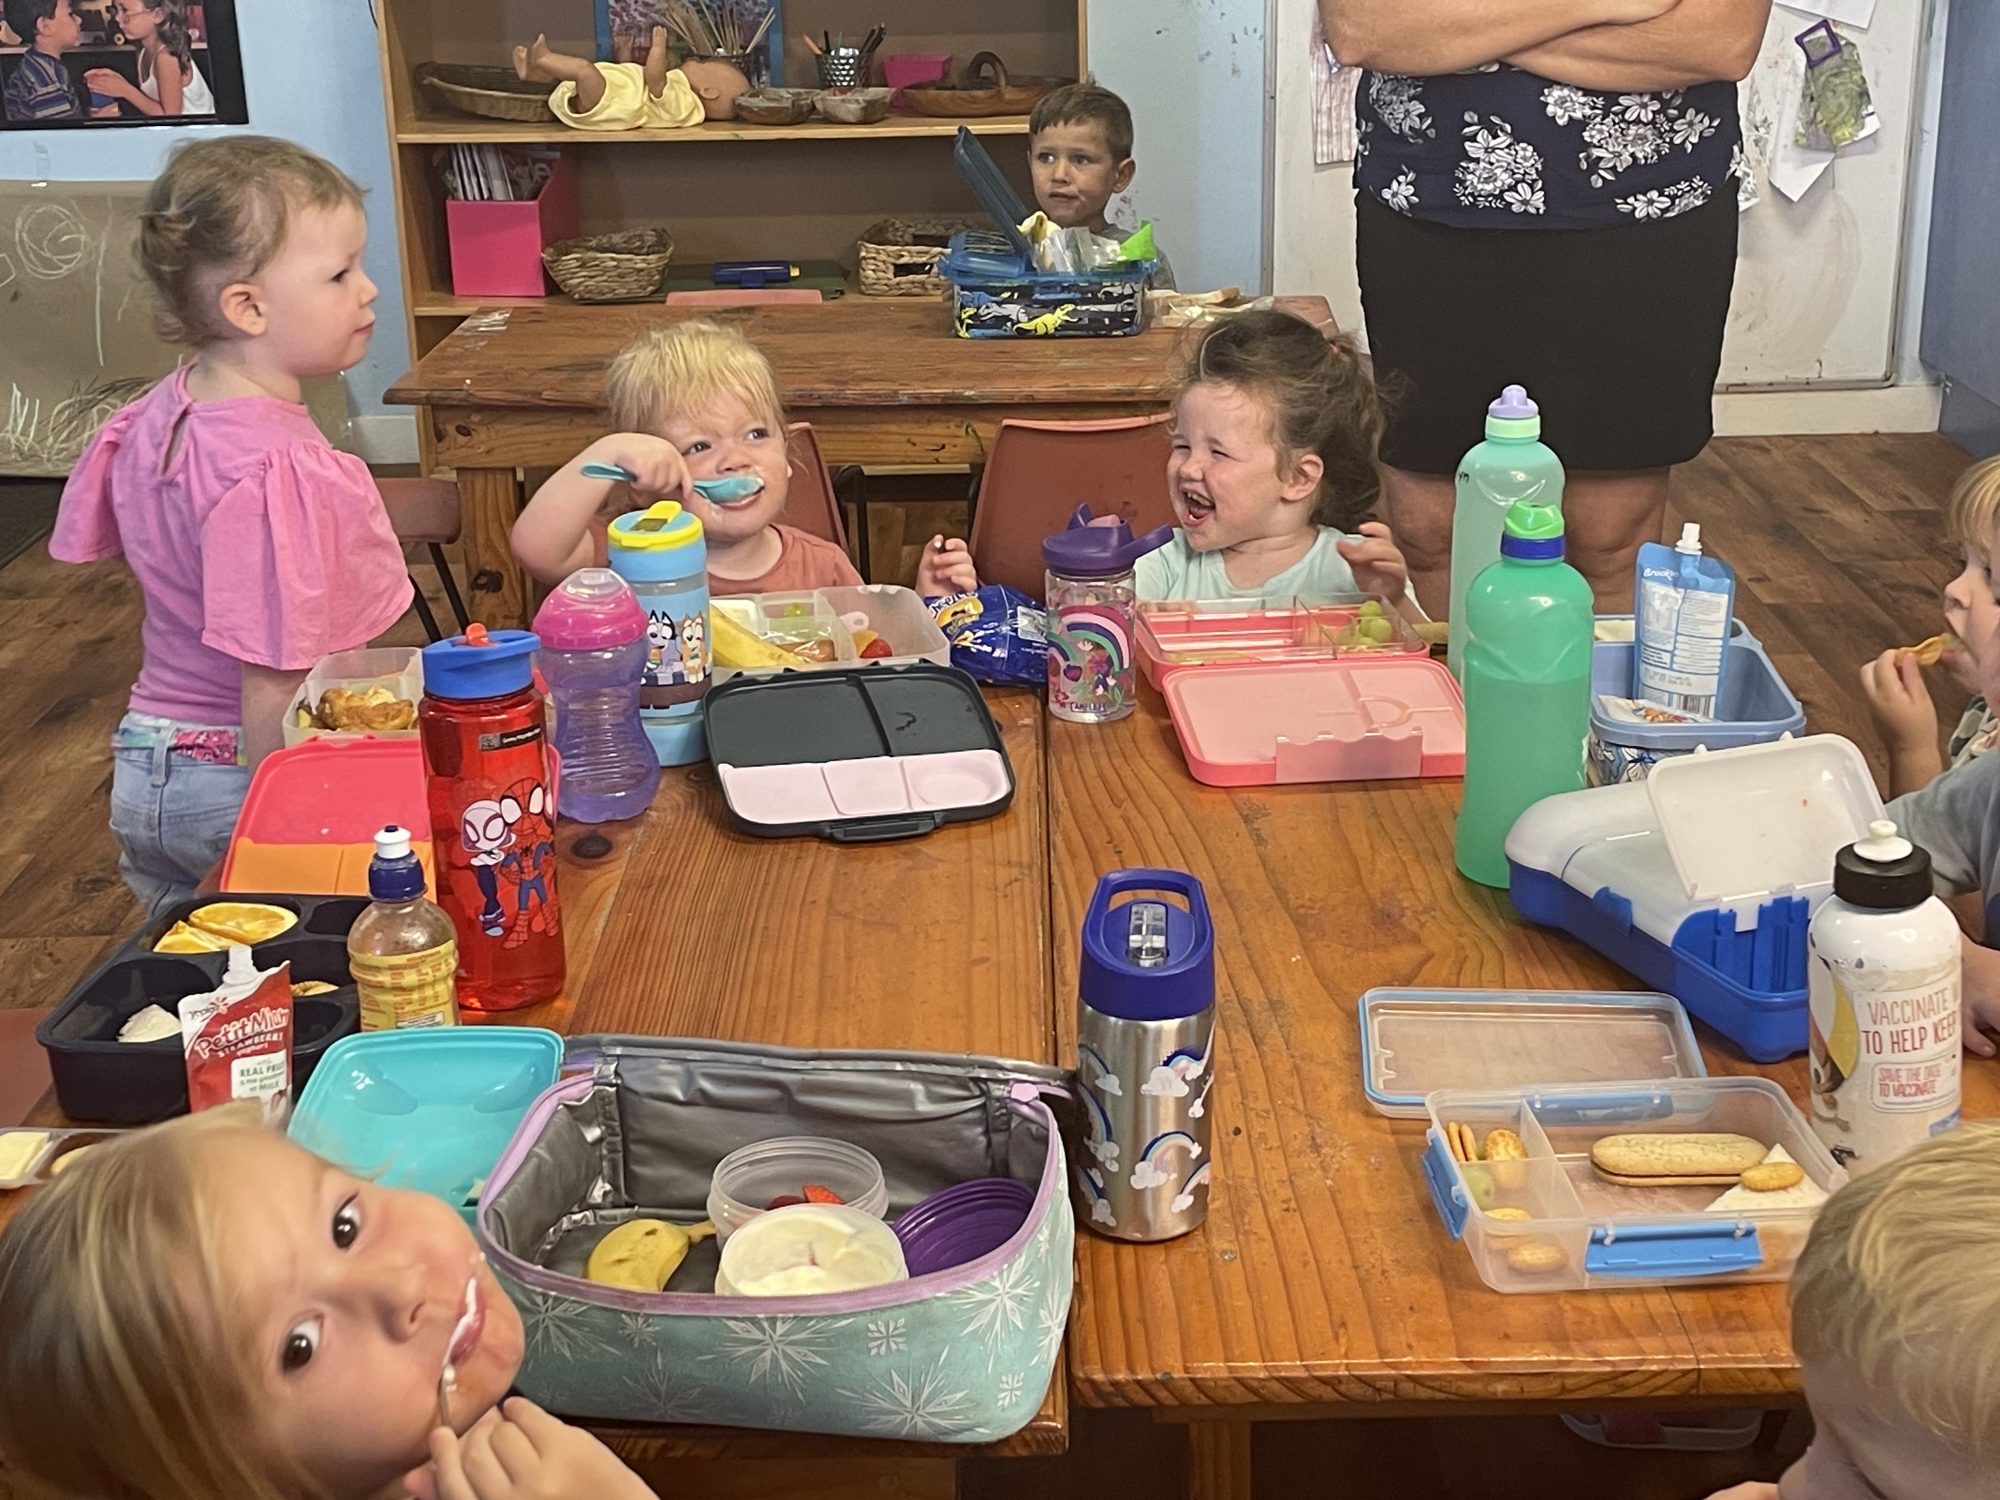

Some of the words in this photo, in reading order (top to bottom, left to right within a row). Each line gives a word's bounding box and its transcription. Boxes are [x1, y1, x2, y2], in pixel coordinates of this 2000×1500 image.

[1867, 987, 1949, 1026] VACCINATE
[1861, 1030, 1883, 1055] TO
[1890, 1026, 1928, 1054] HELP
[240, 1066, 264, 1077] REAL
